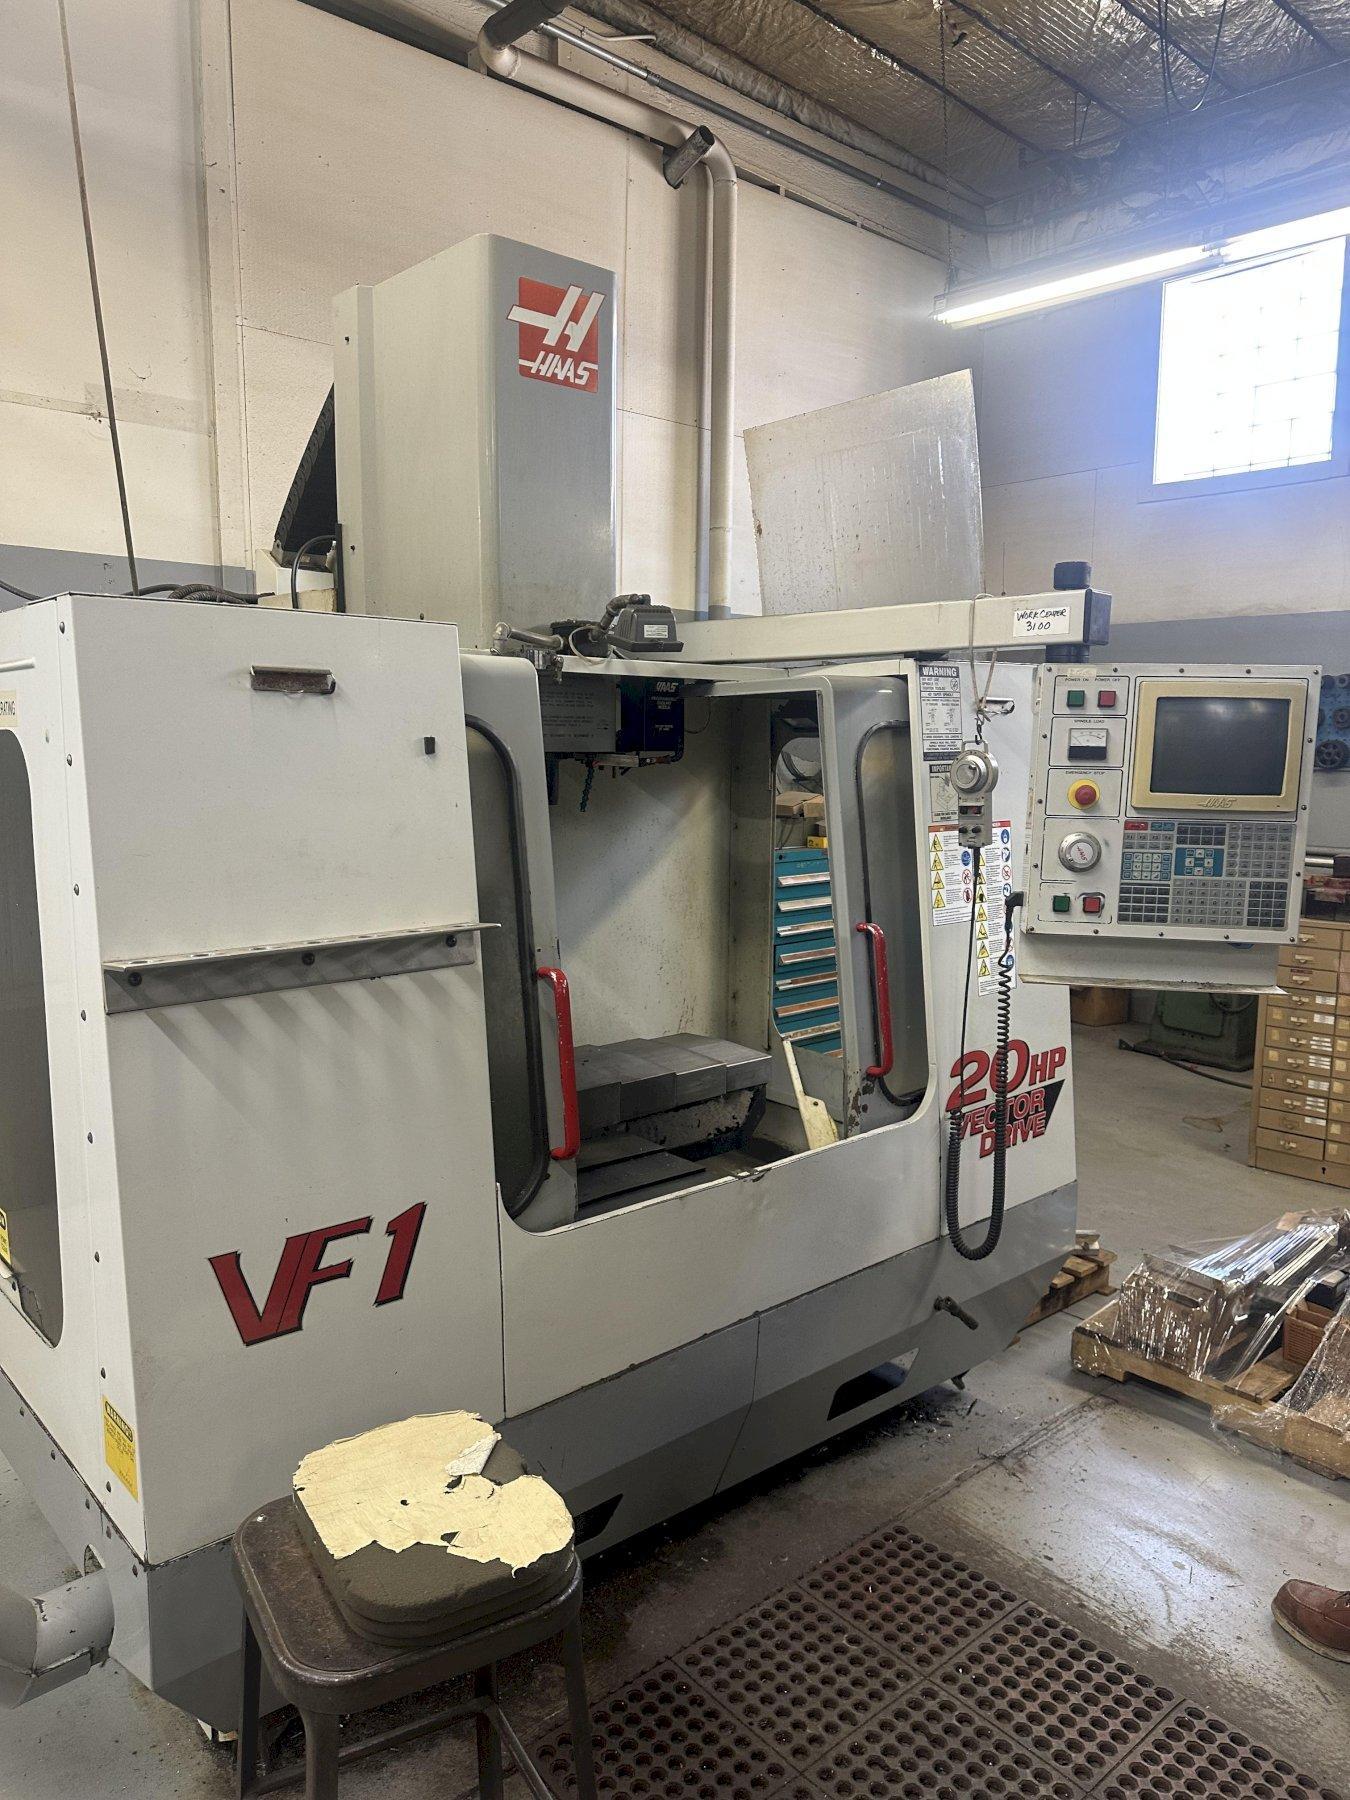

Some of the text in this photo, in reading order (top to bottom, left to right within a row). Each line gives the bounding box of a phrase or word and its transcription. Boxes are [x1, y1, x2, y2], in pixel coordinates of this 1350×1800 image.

[519, 351, 598, 385] HAAS
[1016, 608, 1067, 621] WORK CENTER
[1026, 620, 1051, 631] 3100
[922, 666, 957, 677] WARNING
[960, 1088, 1046, 1140] VECTOR
[979, 1111, 1046, 1159] DRIVE
